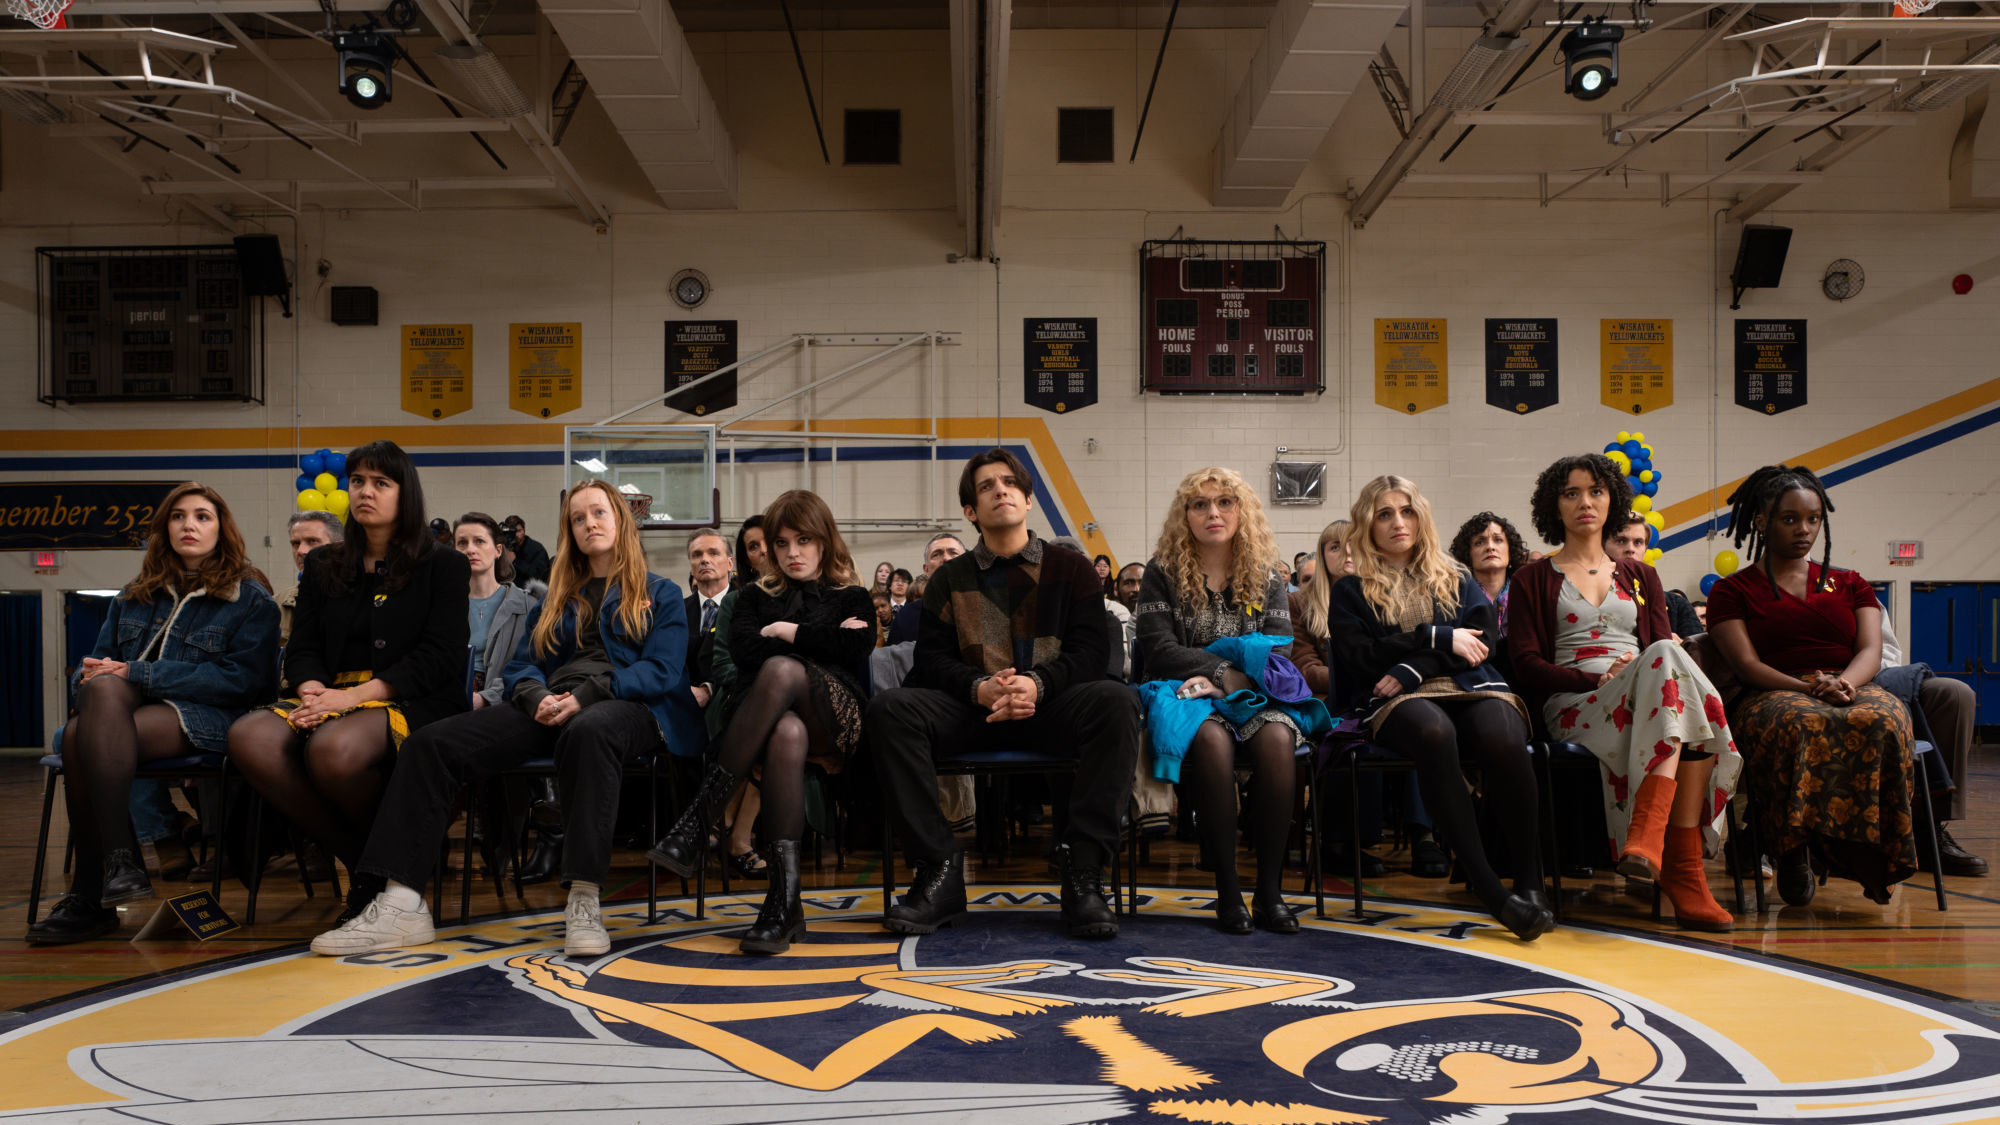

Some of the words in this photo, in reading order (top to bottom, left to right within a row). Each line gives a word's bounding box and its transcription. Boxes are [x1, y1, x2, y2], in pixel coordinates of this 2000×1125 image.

[1224, 300, 1243, 308] POSS
[130, 308, 166, 324] period
[1216, 308, 1250, 318] PERIOD
[528, 326, 564, 335] WISKAYOK
[684, 325, 718, 334] WISKAYOK
[1043, 322, 1077, 331] WISKAYOK
[1392, 322, 1430, 331] WISKAYOK
[1504, 323, 1538, 332] WISKAYOK
[1618, 322, 1656, 331] WISKAYOK
[1754, 323, 1788, 332] WISKAYOK
[418, 327, 456, 336] WISKAYOK
[1035, 331, 1086, 340] YELLOWJACKETS
[1158, 329, 1196, 341] HOME
[1264, 328, 1314, 341] VISITOR
[1496, 331, 1547, 340] YELLOWJACKETS
[1745, 332, 1796, 340] YELLOWJACKETS
[518, 336, 574, 345] YELLOWJACKETS
[676, 333, 726, 342] YELLOWJACKETS
[1383, 332, 1440, 341] YELLOWJACKETS
[1609, 332, 1665, 341] YELLOWJACKETS
[409, 337, 465, 346] YELLOWJACKETS
[1162, 344, 1191, 353] FOULS
[1216, 344, 1229, 353] NO
[1248, 344, 1255, 353] F
[1275, 344, 1304, 353] FOULS
[104, 505, 153, 534] 252
[1899, 543, 1916, 557] EXIT
[37, 551, 55, 566] EXIT
[197, 910, 212, 921] FOR
